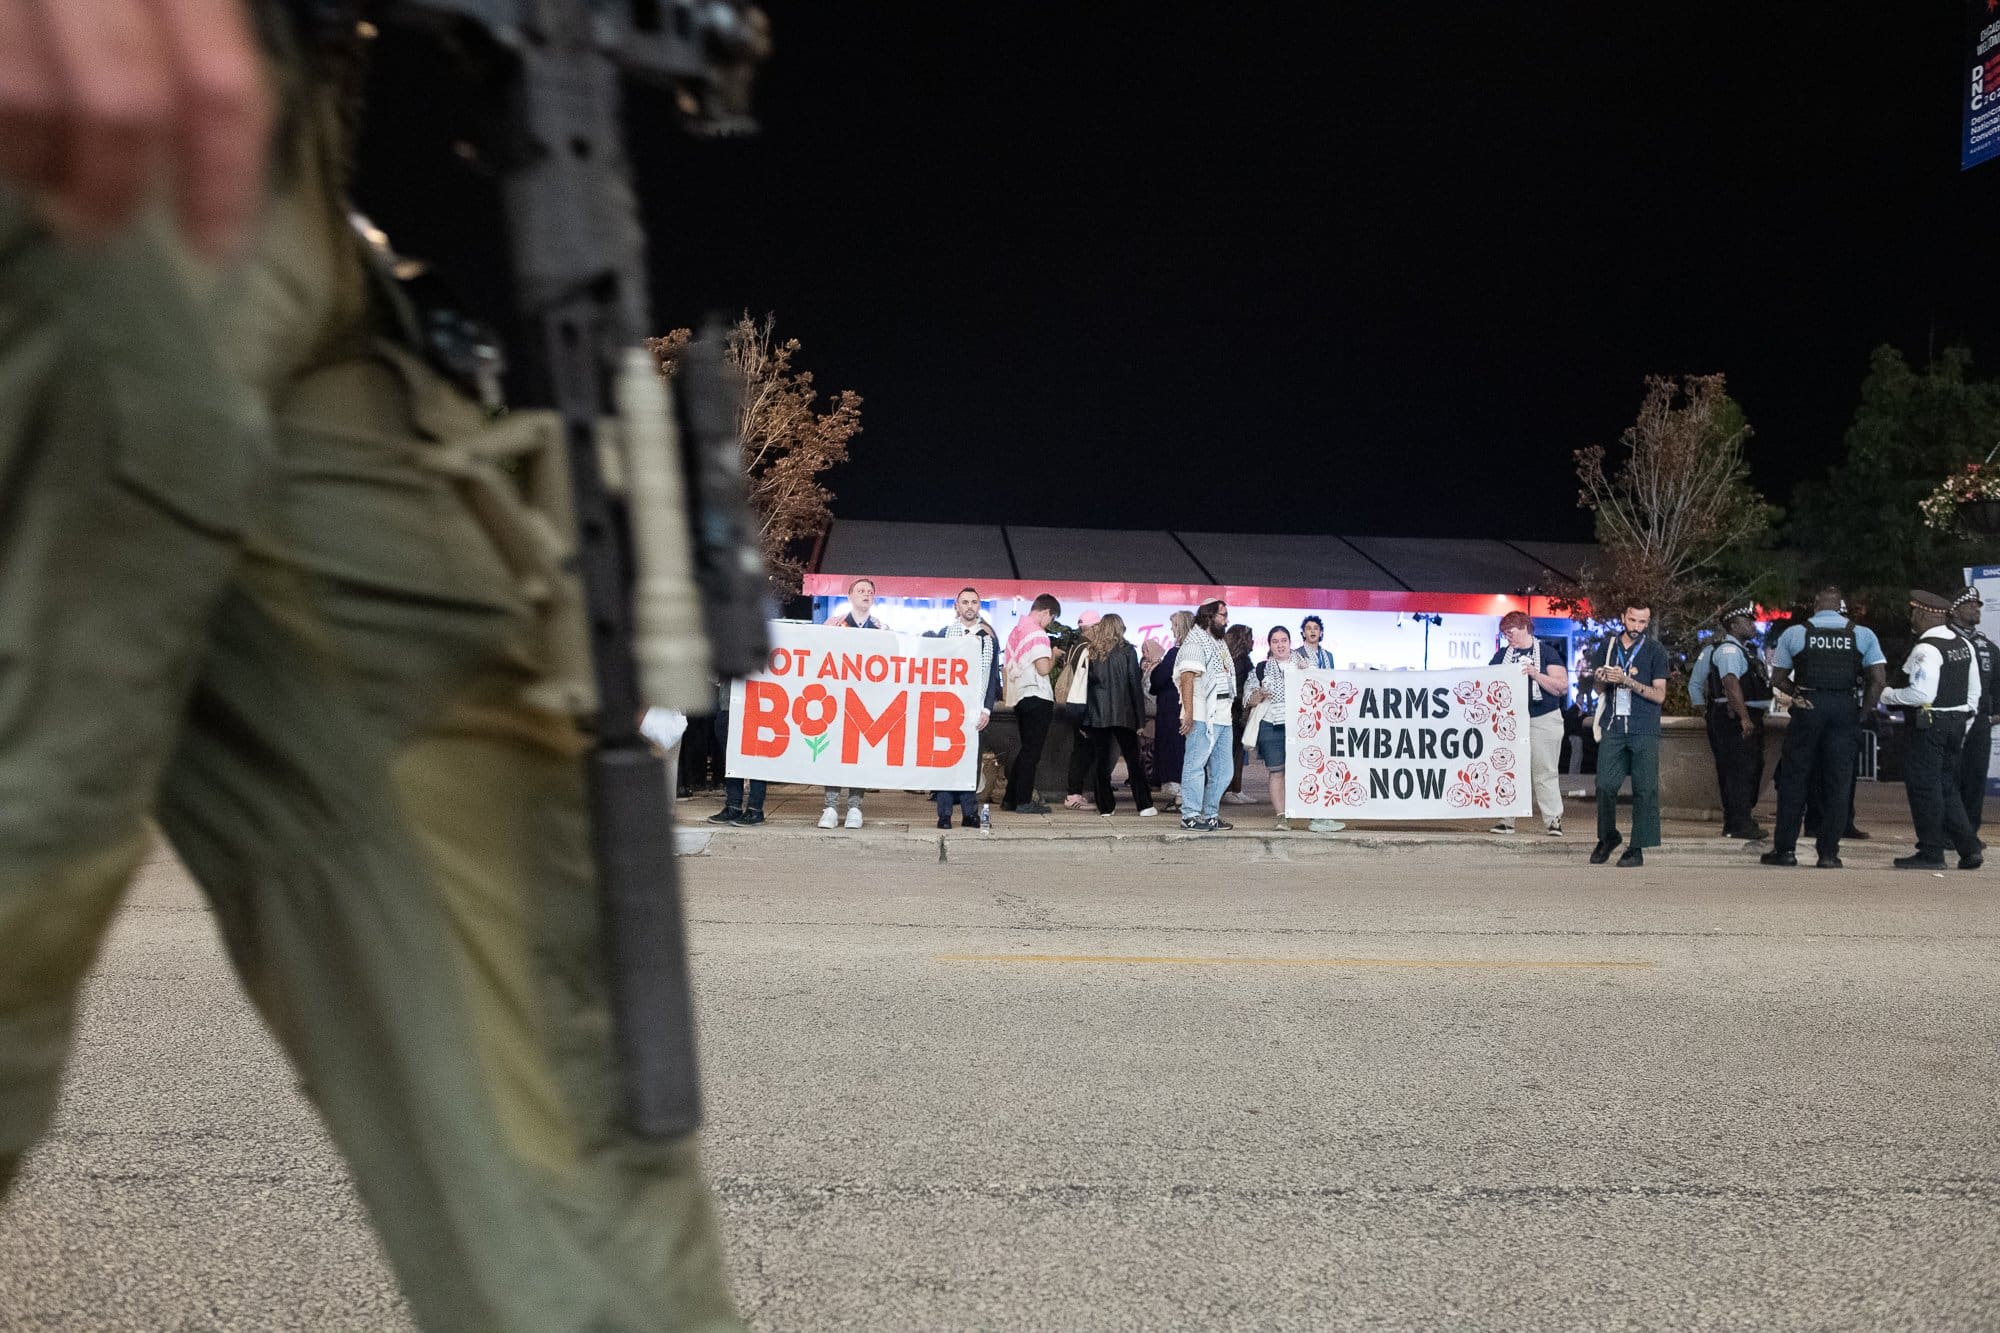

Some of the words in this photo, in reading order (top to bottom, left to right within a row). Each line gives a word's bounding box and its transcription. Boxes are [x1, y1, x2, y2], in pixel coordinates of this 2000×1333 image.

[1980, 20, 2000, 42] CHICAG
[1971, 65, 1984, 111] DNC
[1984, 88, 2000, 106] 202
[1971, 106, 2000, 126] Democr
[1970, 126, 2000, 144] Convent
[1448, 640, 1481, 660] DNC
[1810, 636, 1851, 649] POLICE
[760, 648, 811, 677] OT
[817, 651, 969, 686] ANOTHER
[1359, 687, 1451, 720] ARMS
[740, 680, 967, 768] BOMB
[1329, 726, 1484, 760] EMBARGO
[1369, 767, 1447, 800] NOW
